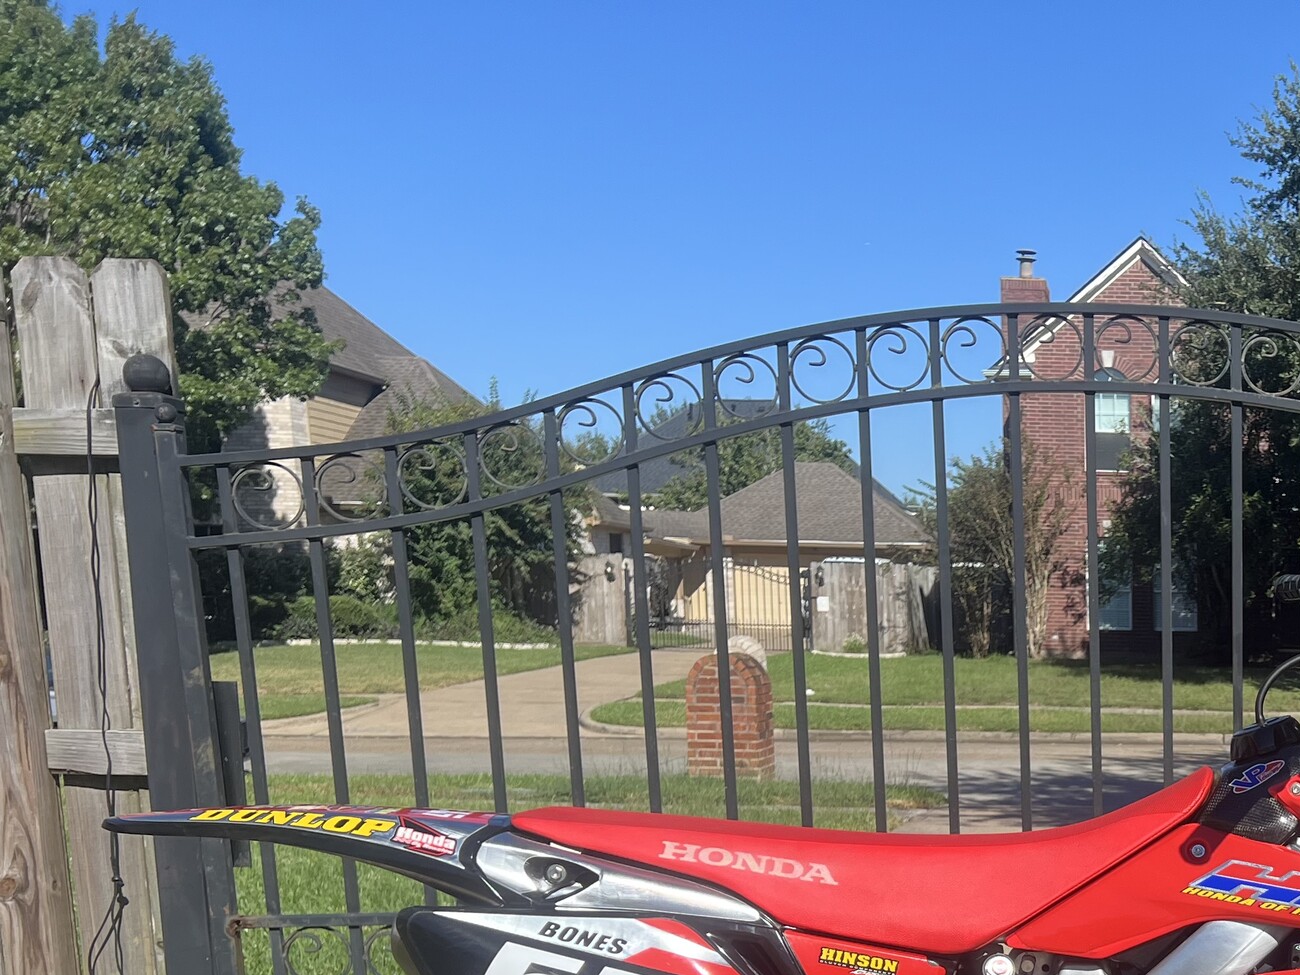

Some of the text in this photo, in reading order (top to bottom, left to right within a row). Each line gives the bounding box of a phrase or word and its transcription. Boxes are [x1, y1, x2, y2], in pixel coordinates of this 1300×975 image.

[189, 809, 396, 838] DUNLOP
[395, 826, 457, 850] Honda
[658, 840, 839, 886] HONDA
[1181, 886, 1257, 907] HONDA
[1259, 901, 1292, 912] OF
[537, 921, 628, 955] BONES
[820, 947, 899, 973] HINSON
